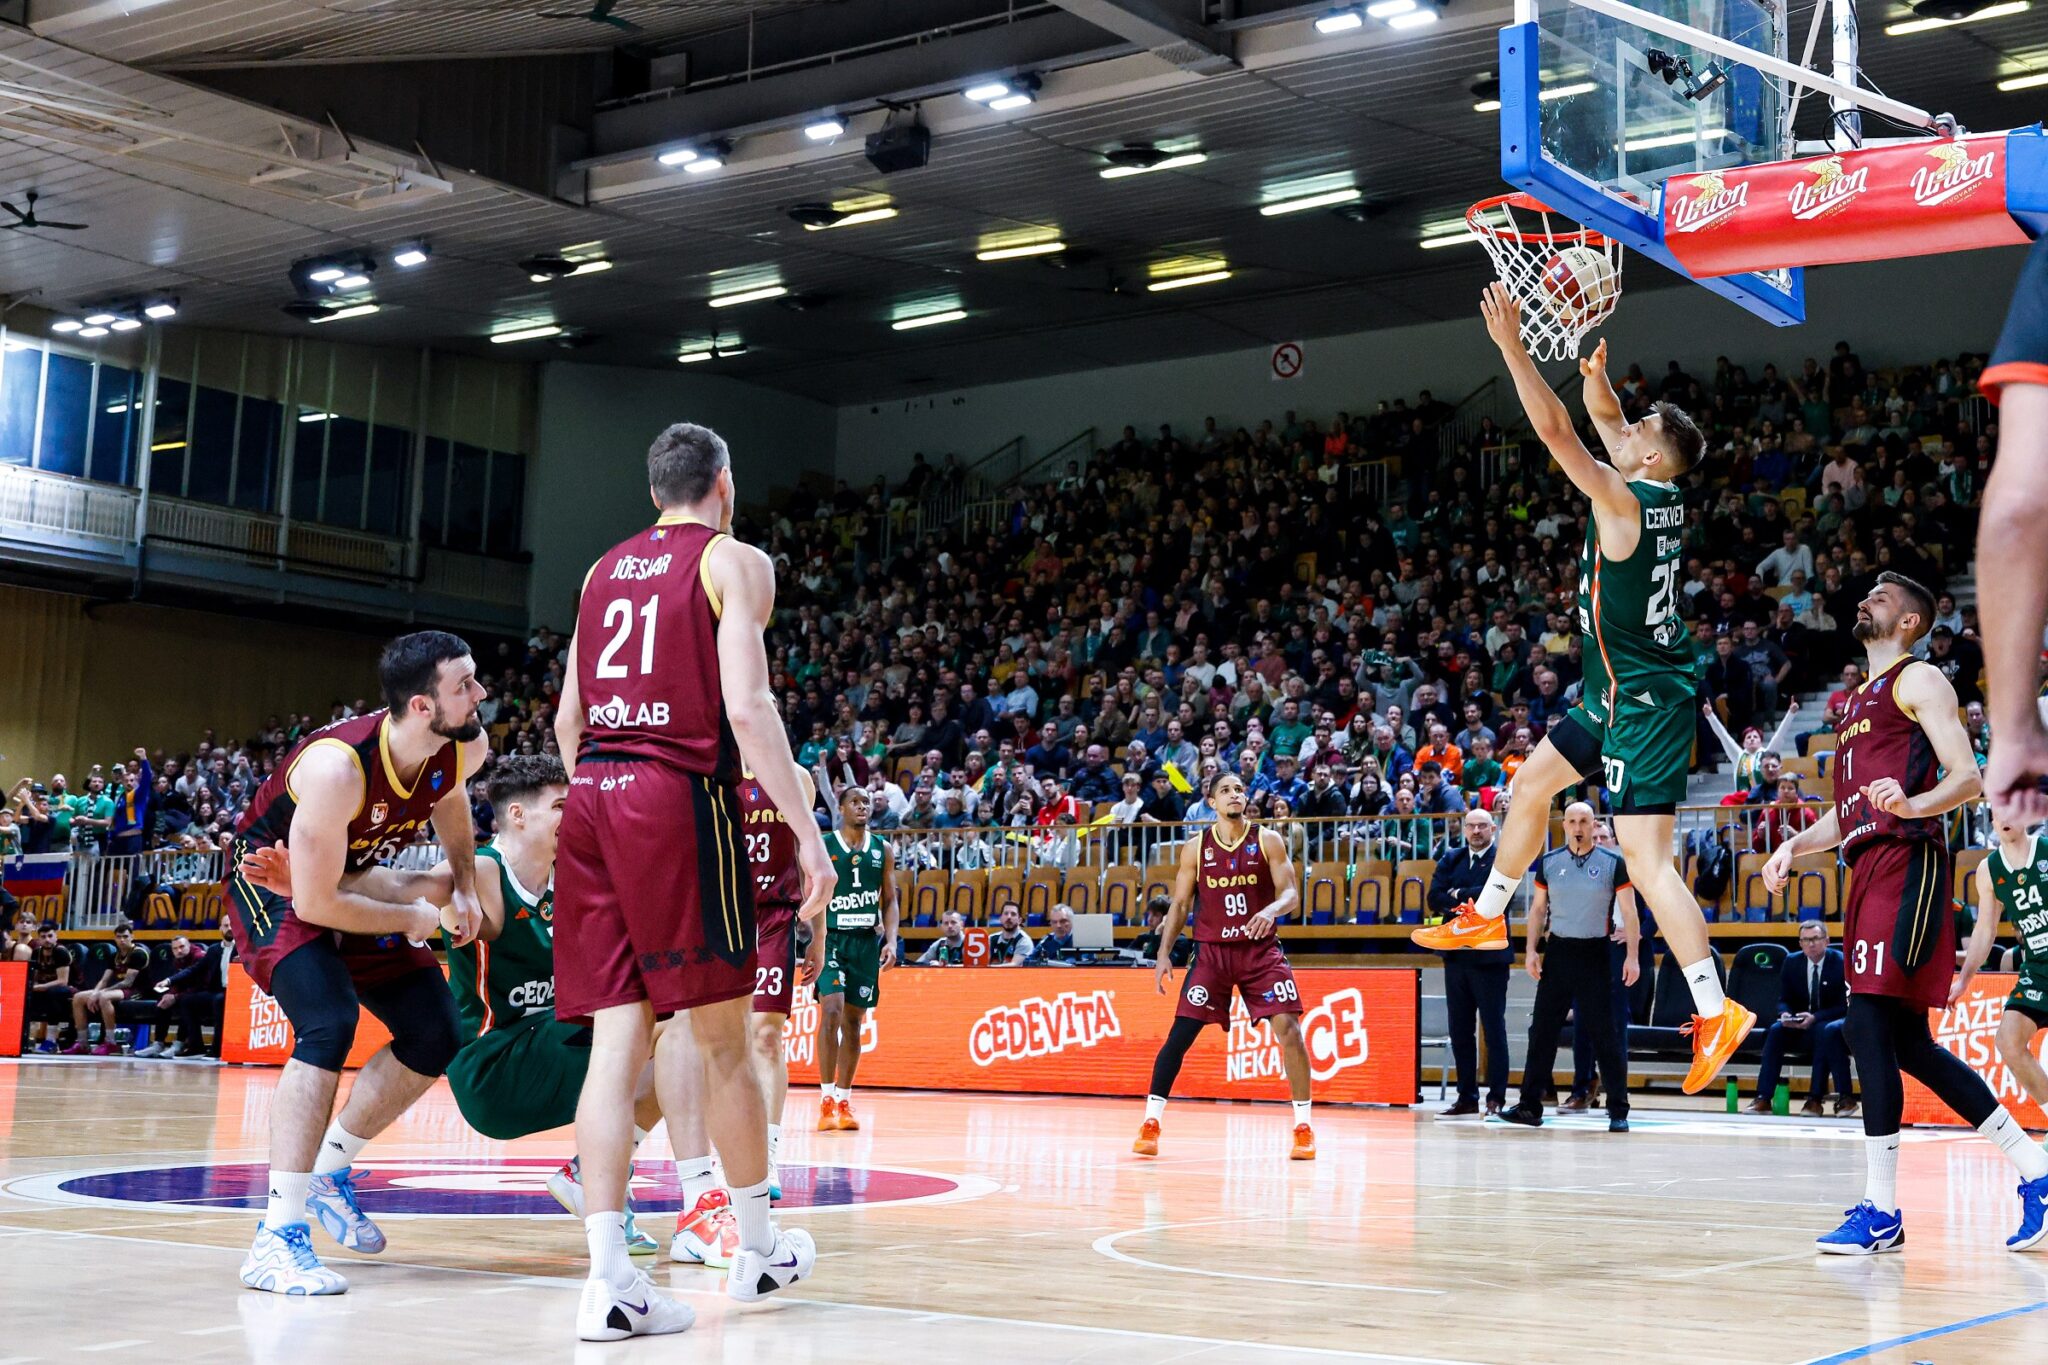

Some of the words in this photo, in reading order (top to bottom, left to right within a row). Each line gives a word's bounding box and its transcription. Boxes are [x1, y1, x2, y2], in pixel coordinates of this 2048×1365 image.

[1788, 166, 1868, 215] Union
[1910, 152, 1995, 201] Union
[1671, 181, 1749, 228] Union
[596, 594, 659, 679] 21
[1842, 747, 1853, 783] 1
[852, 867, 862, 887] 1
[1206, 874, 1257, 888] bosna
[1225, 893, 1247, 916] 99
[2013, 885, 2043, 911] 24
[967, 933, 986, 958] 5
[1855, 939, 1885, 975] 31
[752, 967, 783, 995] 23
[1273, 980, 1298, 1003] 99
[248, 1021, 288, 1050] NEKAJ
[969, 990, 1121, 1066] CEDEVITA
[782, 1034, 814, 1066] KAJ
